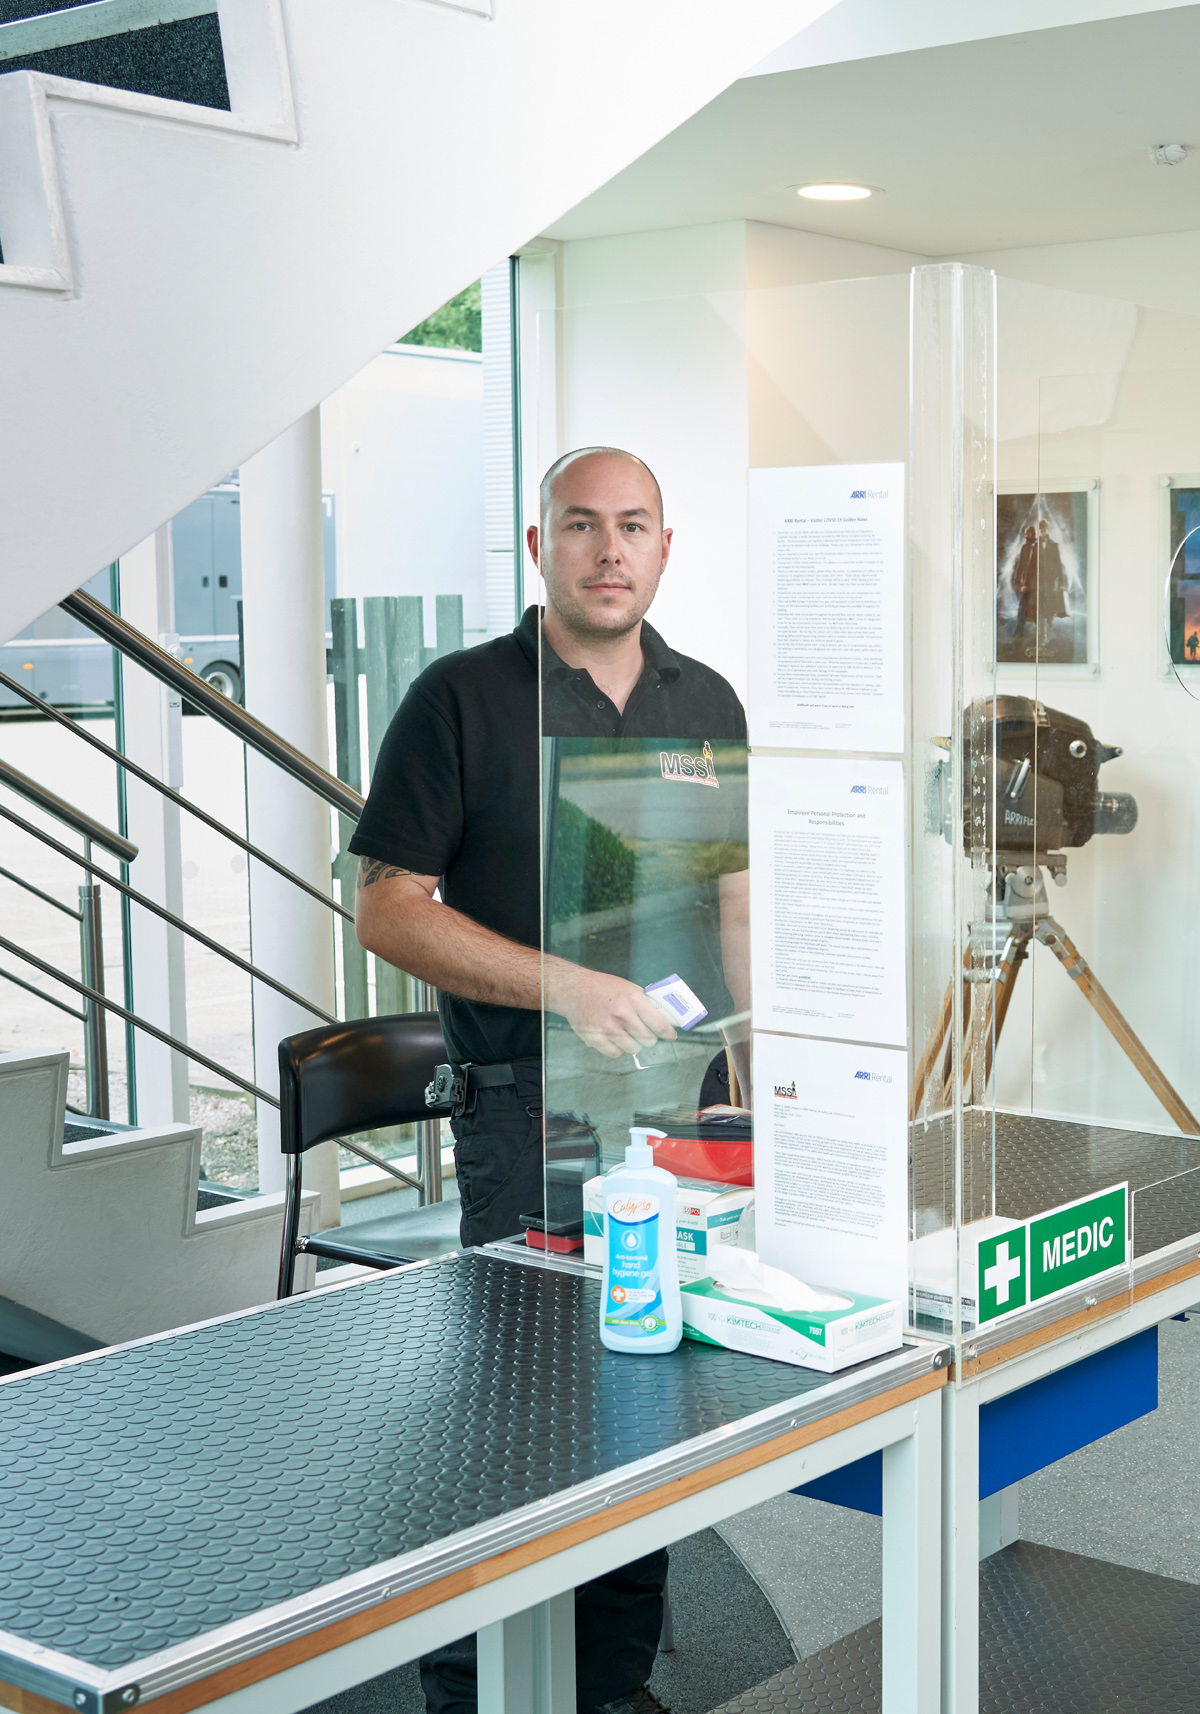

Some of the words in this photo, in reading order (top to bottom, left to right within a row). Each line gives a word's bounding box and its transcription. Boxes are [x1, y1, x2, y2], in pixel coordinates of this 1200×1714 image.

[850, 490, 866, 499] ARRI
[867, 490, 888, 499] Rental
[850, 785, 866, 794] ARRI
[867, 785, 889, 795] Rental
[787, 809, 810, 817] Employee
[854, 1071, 870, 1080] ARRI
[871, 1072, 893, 1083] Rental
[612, 1197, 651, 1216] Calypso
[691, 1207, 700, 1215] PCS
[677, 1230, 694, 1241] ASK
[1042, 1216, 1114, 1273] MEDIC
[622, 1261, 641, 1269] hand
[612, 1269, 640, 1278] hygiene
[640, 1269, 653, 1279] gel
[708, 1312, 717, 1321] 100
[726, 1314, 762, 1331] KIMTECH
[855, 1316, 881, 1331] KIMTECH
